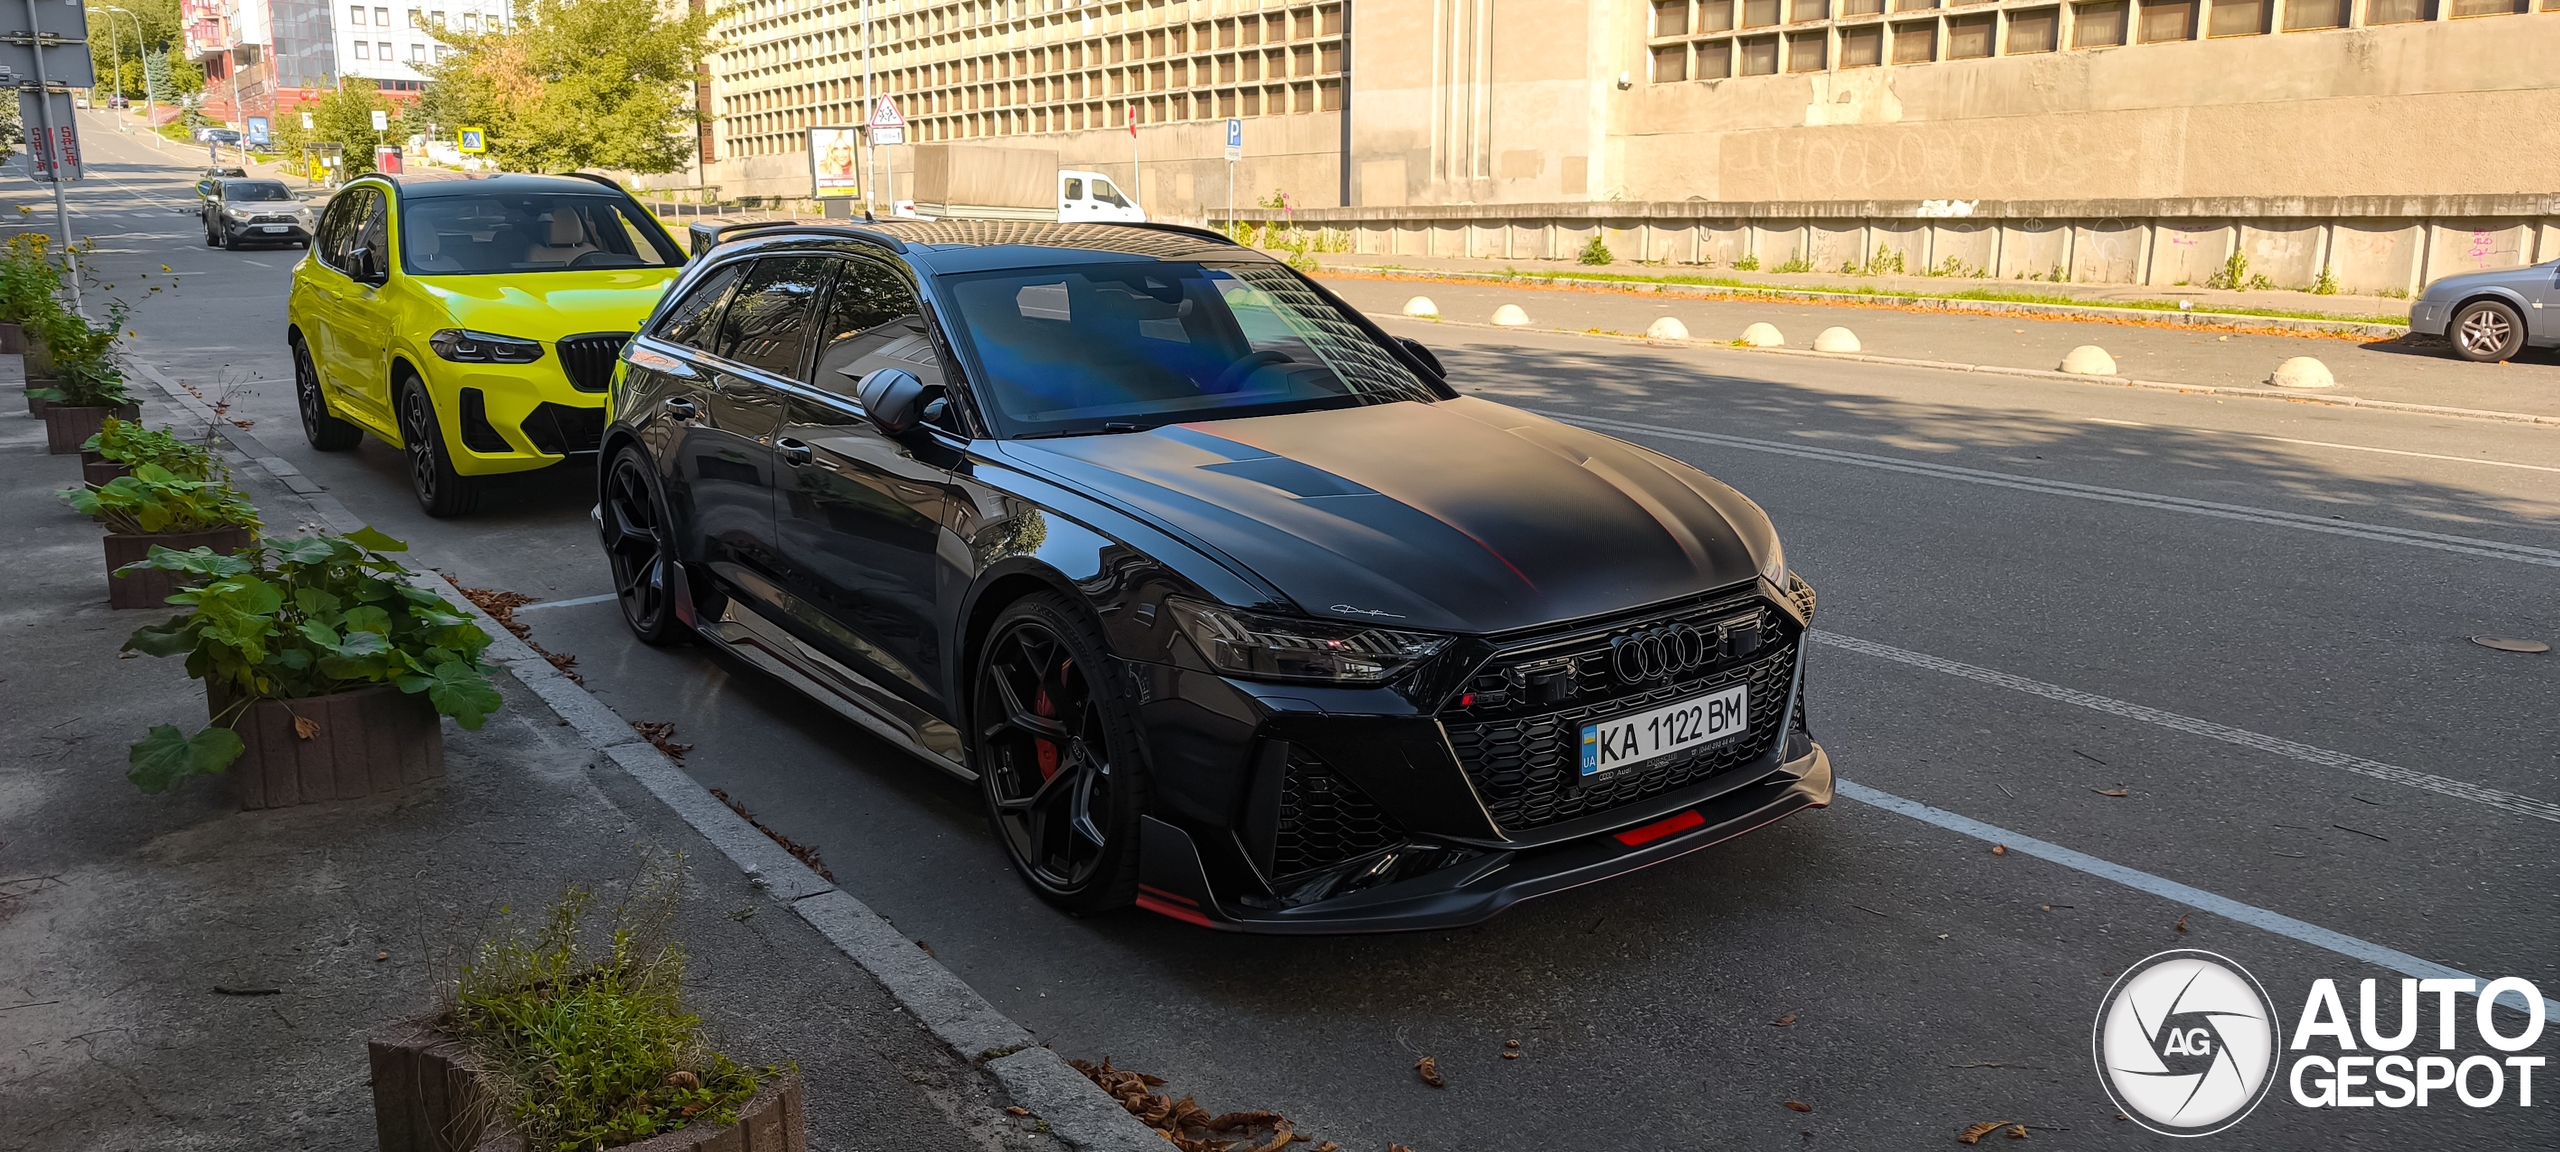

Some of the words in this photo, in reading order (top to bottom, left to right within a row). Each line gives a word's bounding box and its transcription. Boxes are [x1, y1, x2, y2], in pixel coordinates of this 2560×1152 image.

[1230, 120, 1240, 144] P
[1583, 756, 1596, 769] UA
[1600, 723, 1639, 765] KA
[1647, 706, 1703, 751] 1122
[1708, 693, 1742, 734] BM
[1617, 767, 1632, 776] Audi
